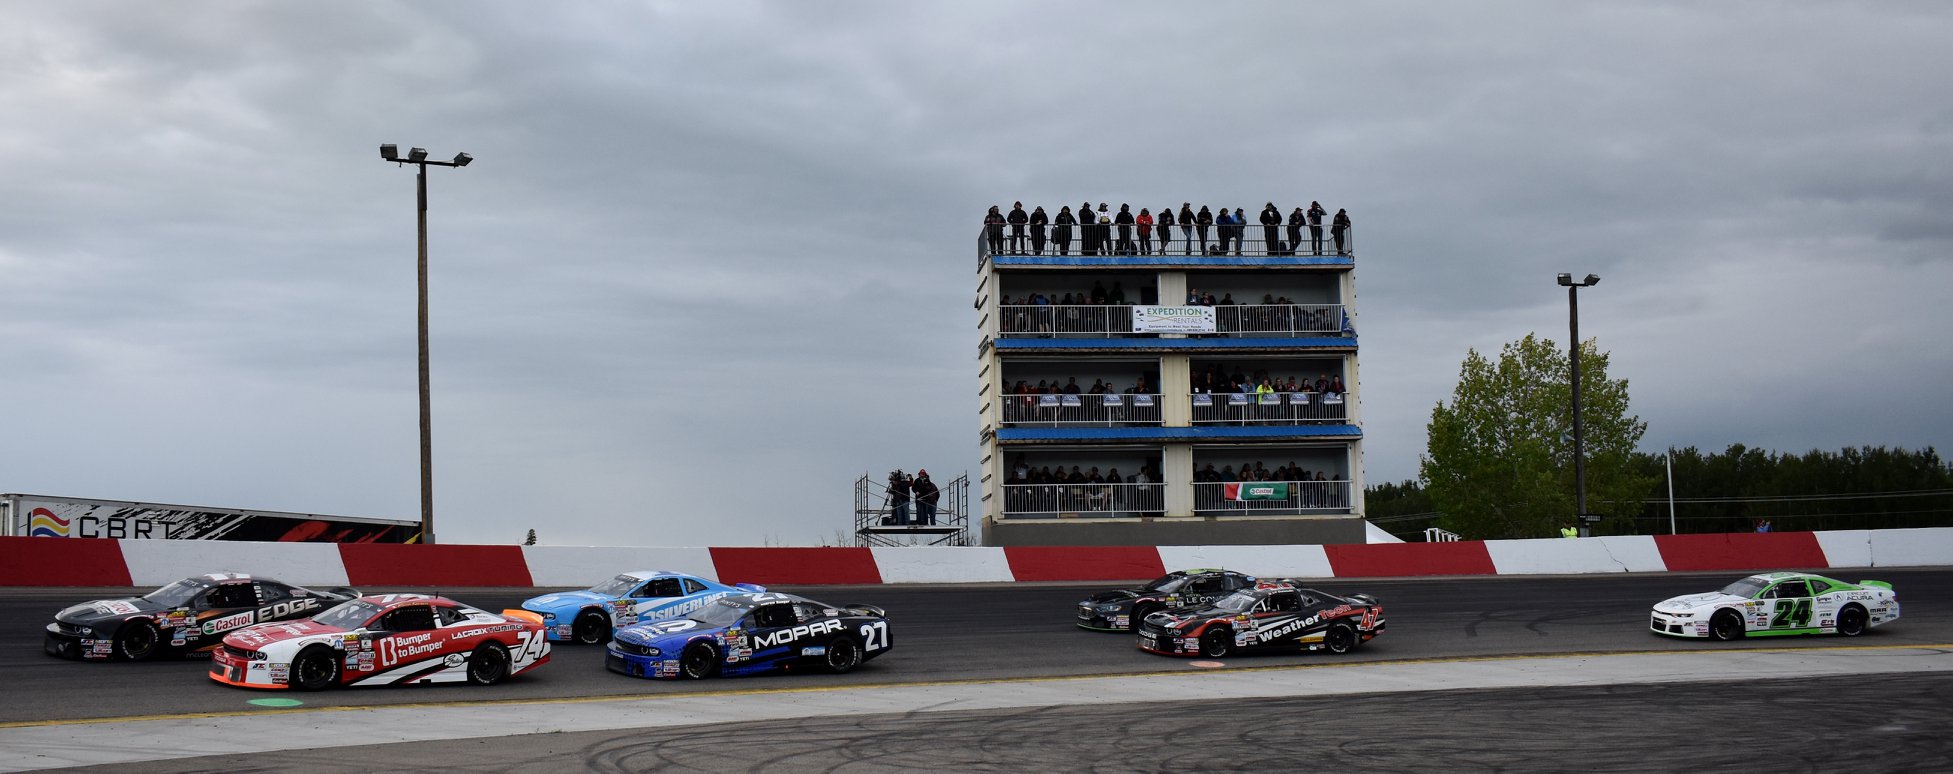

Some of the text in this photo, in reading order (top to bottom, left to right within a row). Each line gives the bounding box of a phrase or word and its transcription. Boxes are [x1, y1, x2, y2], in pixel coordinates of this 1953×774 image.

[79, 516, 176, 539] CBRT
[257, 597, 319, 622] EDGE
[1361, 608, 1379, 632] 47
[1770, 597, 1814, 629] 24
[215, 613, 251, 631] Castrol
[451, 626, 489, 640] LACROIX
[1259, 603, 1352, 643] WeatherTech
[396, 632, 432, 647] Bumper
[513, 629, 546, 663] 74
[754, 619, 843, 650] MOPAR
[860, 620, 889, 652] 27
[398, 640, 444, 658] to Bumper
